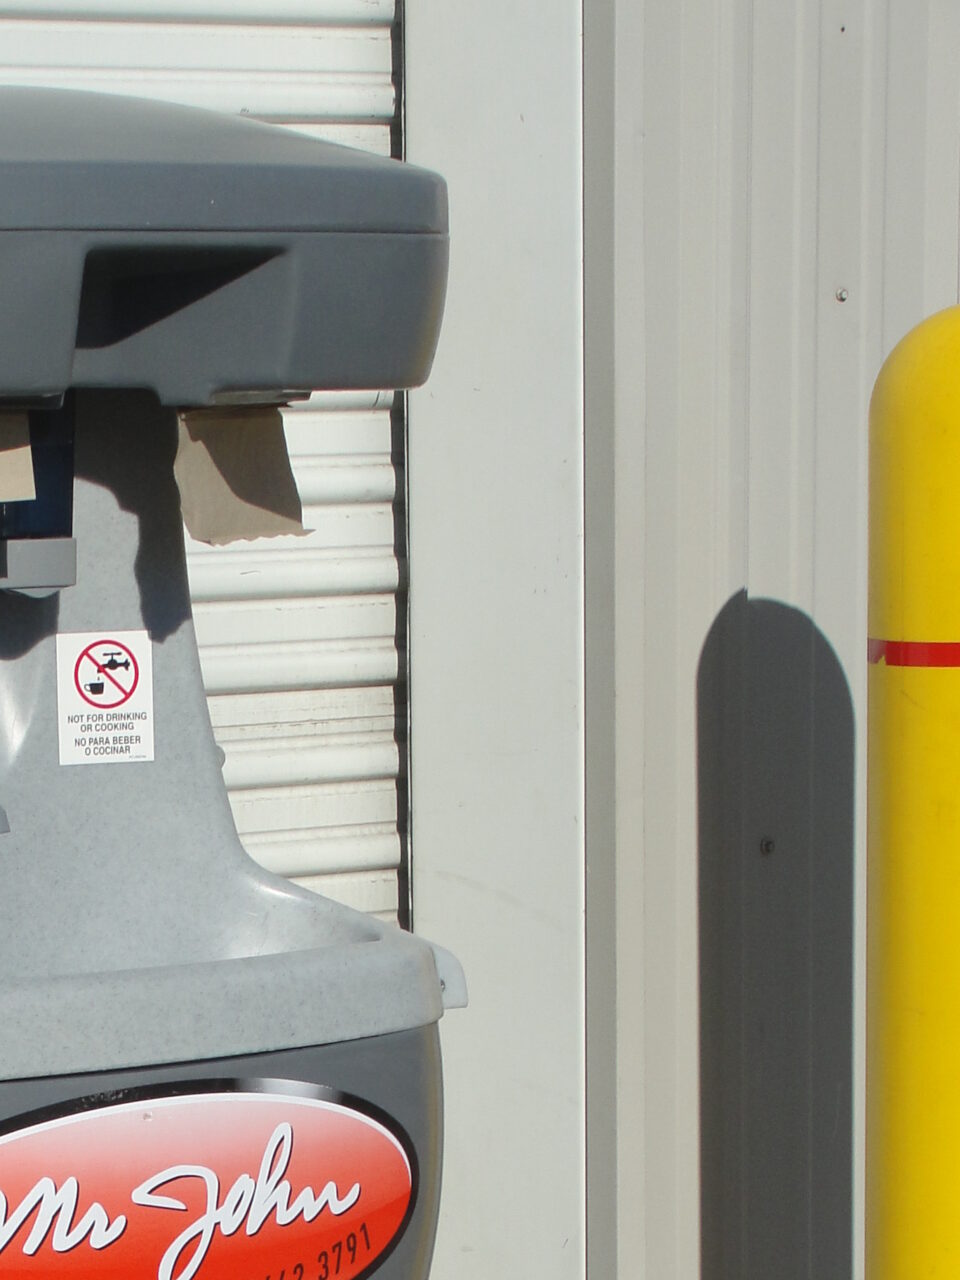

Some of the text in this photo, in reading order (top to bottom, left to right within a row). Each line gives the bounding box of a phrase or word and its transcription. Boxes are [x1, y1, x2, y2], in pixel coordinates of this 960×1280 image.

[67, 712, 147, 724] NOT FOR DRINKING
[80, 722, 134, 733] OR COOKING
[74, 735, 141, 747] NO PARA BEBER
[84, 745, 131, 756] O COCINAR
